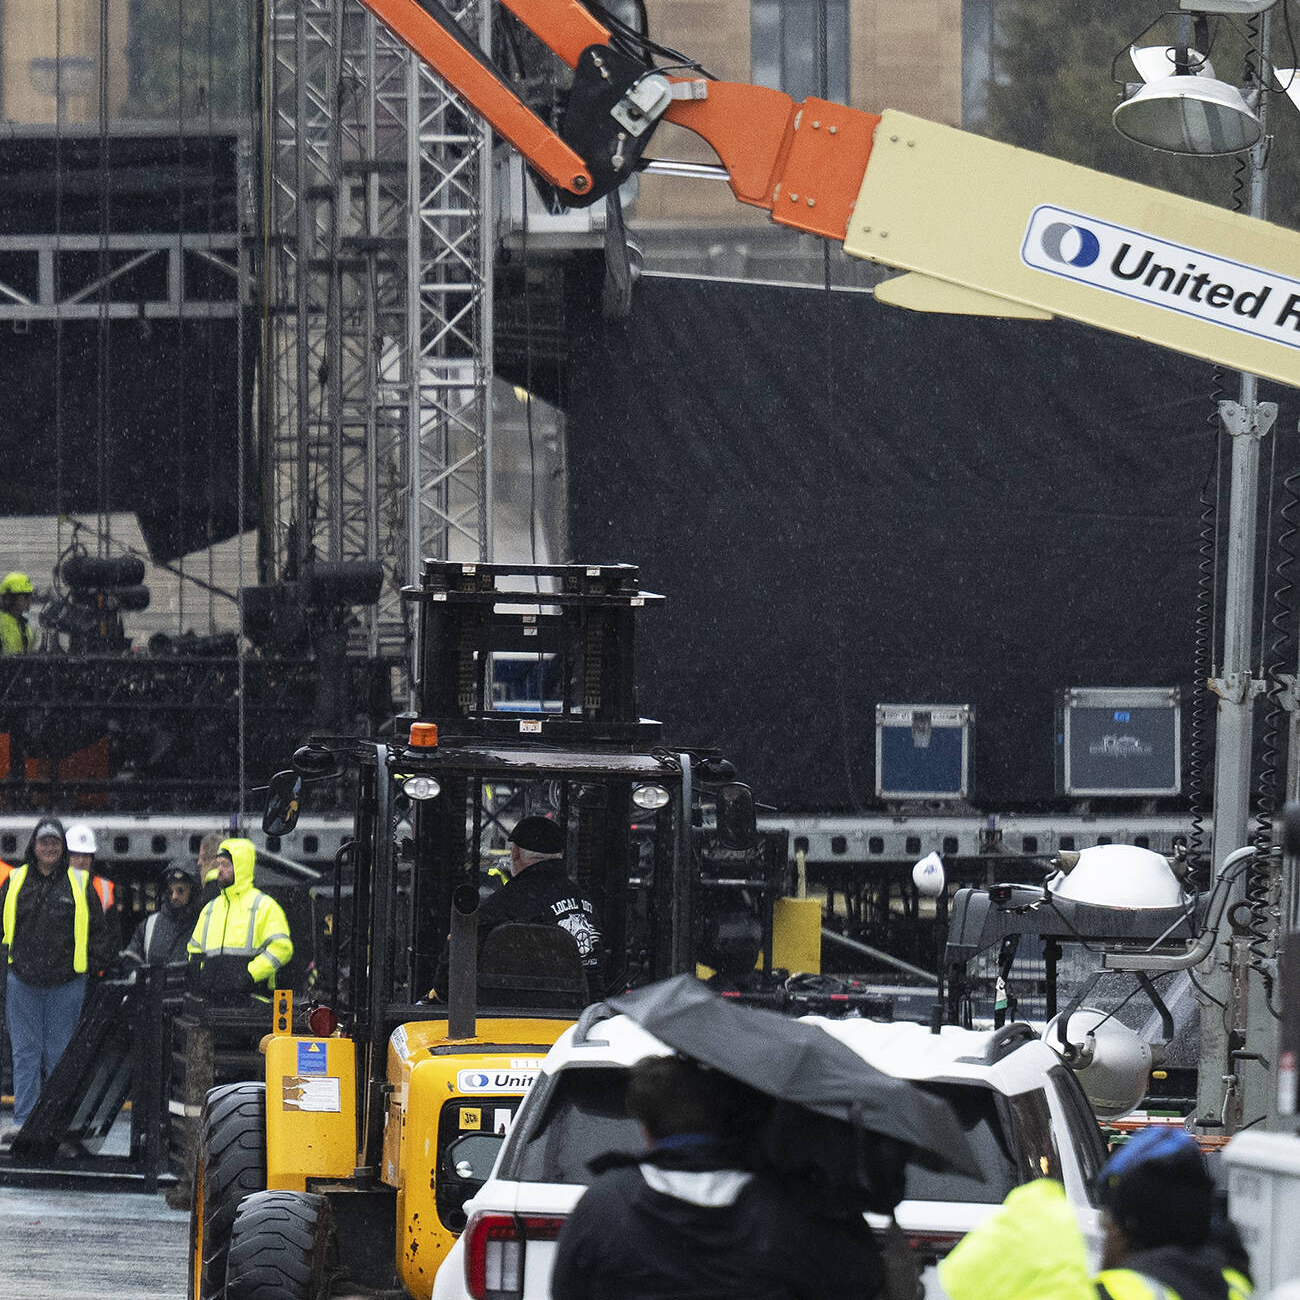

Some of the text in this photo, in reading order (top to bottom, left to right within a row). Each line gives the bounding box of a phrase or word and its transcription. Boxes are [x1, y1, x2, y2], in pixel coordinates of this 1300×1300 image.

[1110, 243, 1272, 319] United
[550, 898, 579, 916] LOCAL
[494, 1074, 535, 1087] Unit
